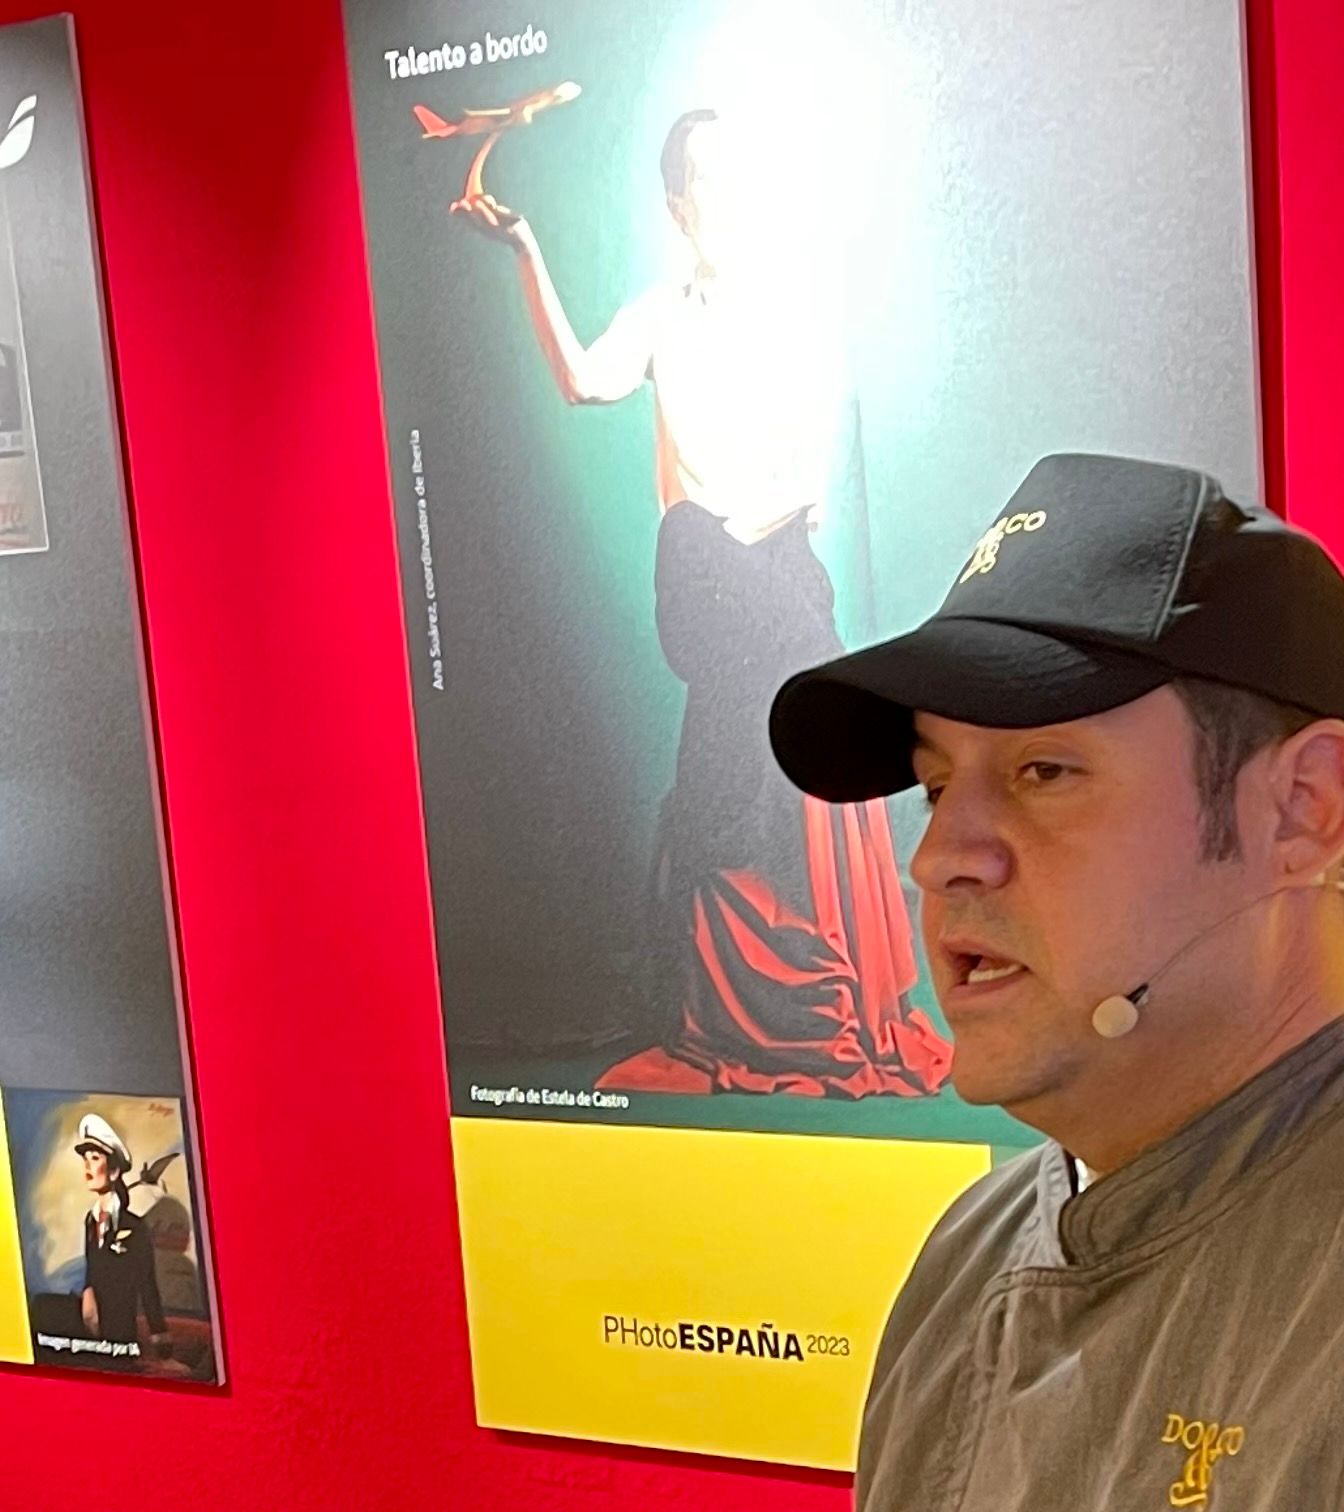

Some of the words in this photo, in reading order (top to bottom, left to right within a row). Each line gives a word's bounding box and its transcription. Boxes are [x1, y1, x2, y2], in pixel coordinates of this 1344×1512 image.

[384, 42, 467, 79] Talento
[469, 41, 483, 65] a
[485, 23, 548, 63] bordo
[603, 1315, 805, 1362] PHotoESPAÑA
[807, 1334, 851, 1356] 2023
